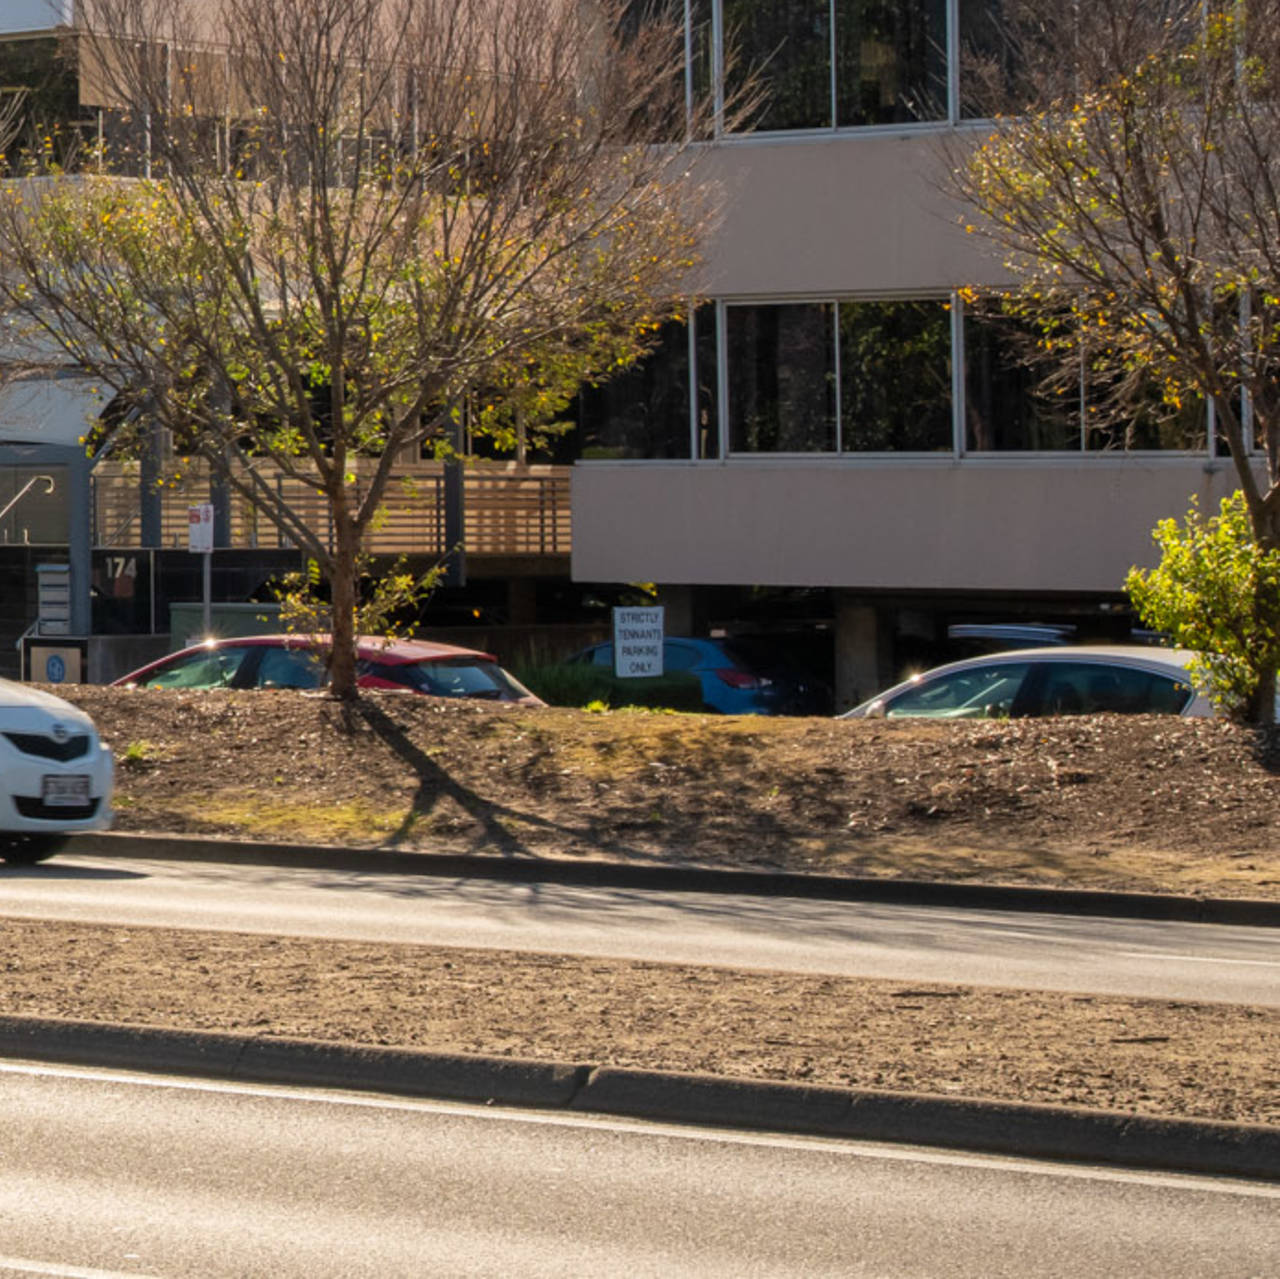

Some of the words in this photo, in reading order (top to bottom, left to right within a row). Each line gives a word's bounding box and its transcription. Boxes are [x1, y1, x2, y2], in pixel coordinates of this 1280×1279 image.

[105, 556, 137, 579] 174
[620, 612, 659, 624] STRICTLY
[622, 645, 658, 657] PARKING
[629, 661, 652, 673] ONLY
